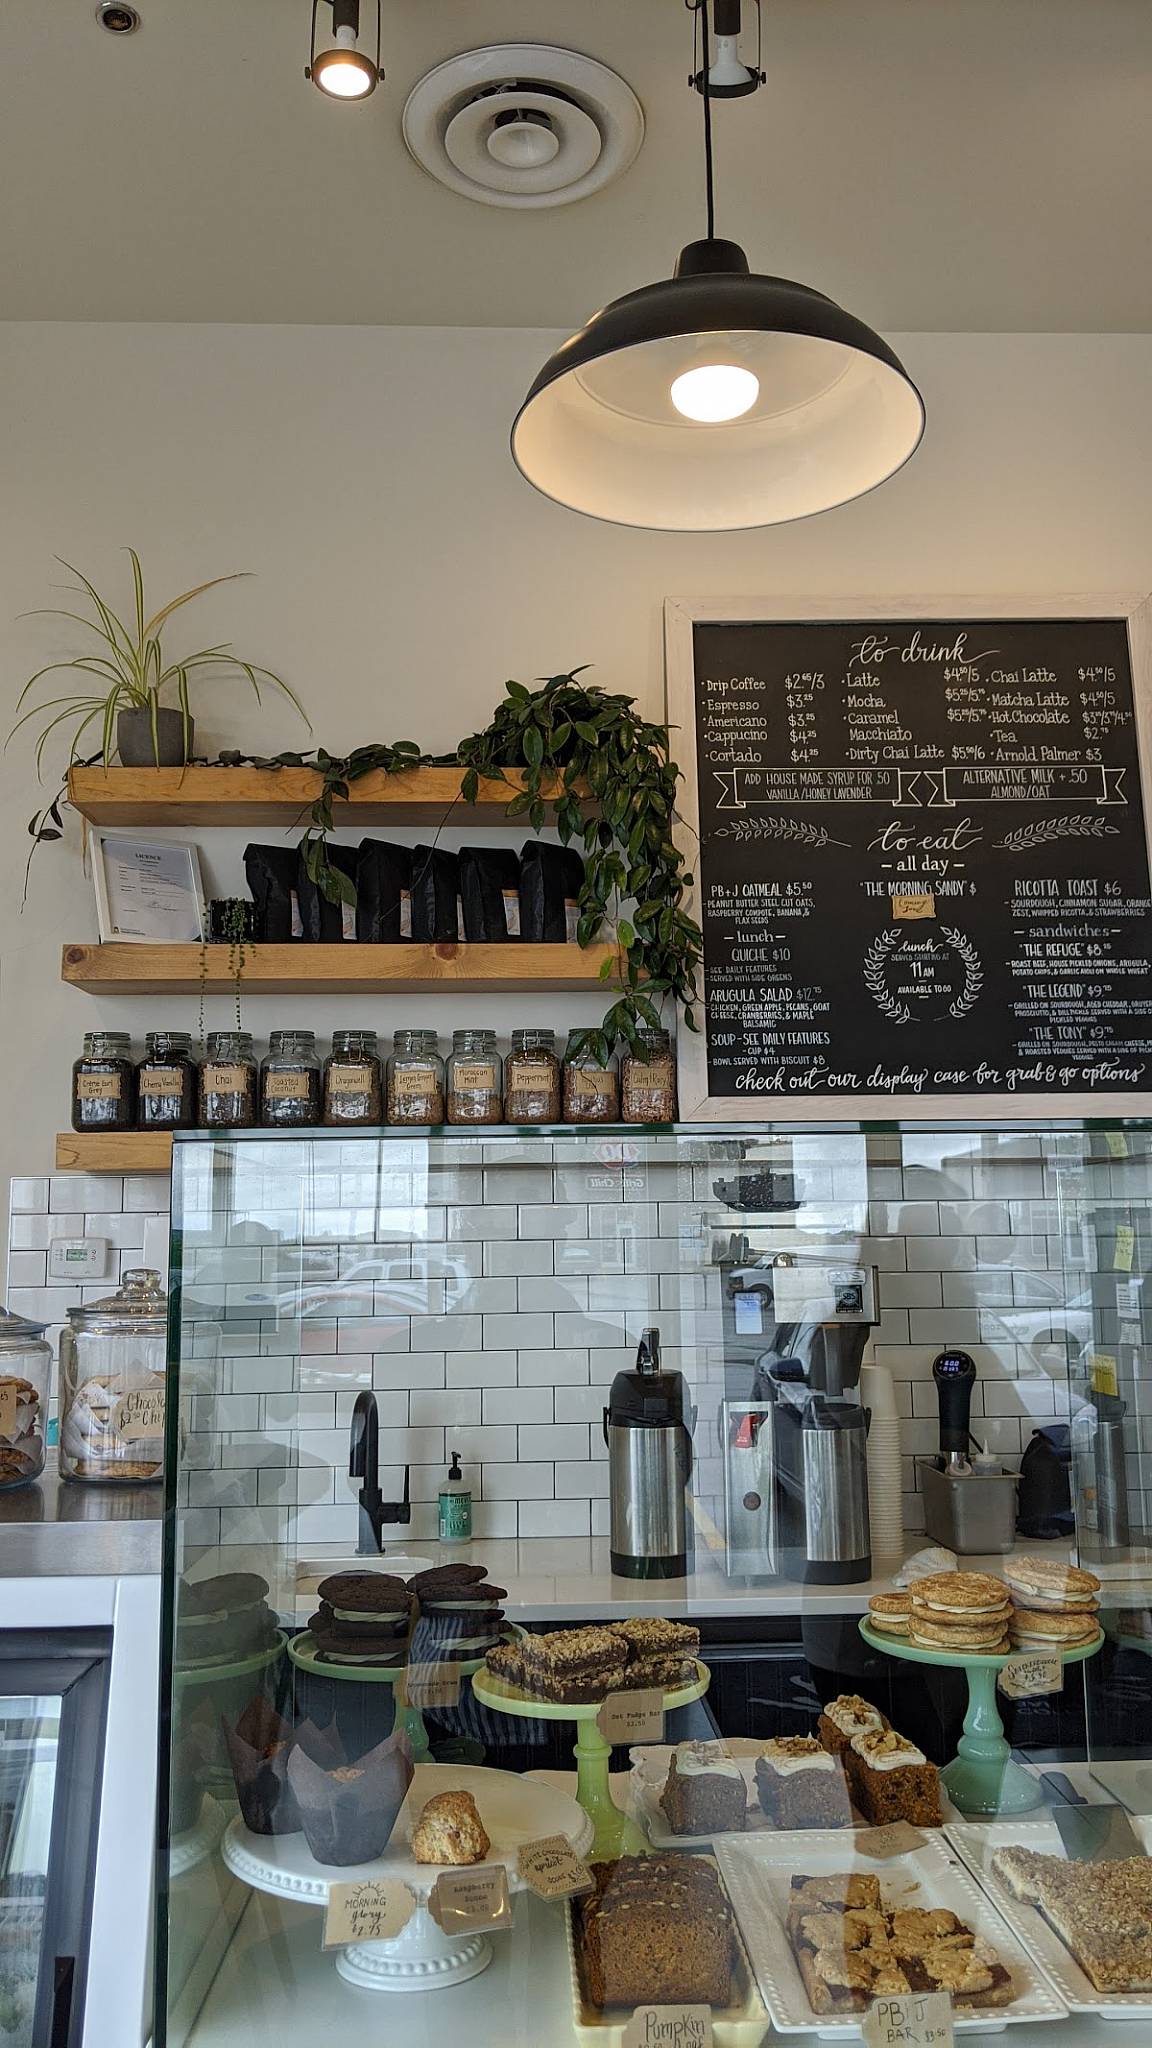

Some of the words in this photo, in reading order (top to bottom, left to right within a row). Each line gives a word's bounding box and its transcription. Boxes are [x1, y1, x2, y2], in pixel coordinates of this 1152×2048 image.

[849, 635, 900, 668] to
[901, 630, 1000, 664] drink
[847, 673, 881, 687] Latte
[991, 670, 1019, 683] Chai
[1022, 668, 1057, 682] Latte
[707, 680, 729, 695] Drip
[730, 677, 766, 690] Coffee
[707, 699, 760, 714] Espresso
[787, 693, 814, 709] $3.25
[848, 694, 886, 708] Mocha
[992, 692, 1035, 706] Matcha
[1036, 692, 1070, 706] Latte
[707, 715, 767, 726] Americano
[788, 713, 815, 727] $3.25
[848, 710, 900, 724] Caramel
[992, 711, 1012, 724] Hot
[1012, 710, 1071, 724] Chocolate
[708, 731, 768, 746] Cappucino
[790, 729, 817, 744] $4.25
[850, 728, 913, 741] Macchiato
[993, 730, 1018, 743] Tea
[709, 747, 762, 763] Cortado
[850, 747, 880, 764] Dirty
[883, 745, 911, 759] Chai
[914, 745, 946, 759] Latte
[996, 747, 1038, 762] Arnold
[1041, 746, 1082, 761] Palmer
[1086, 748, 1102, 761] $3
[744, 773, 761, 785] ADD
[766, 773, 797, 785] HOUSE
[800, 772, 824, 784] MADE
[827, 772, 855, 785] SYRUP
[857, 772, 874, 784] FOR
[963, 770, 1027, 784] ALTERNATIVE
[1031, 769, 1055, 783] MILK
[833, 787, 873, 800] LAVENDER
[990, 785, 1051, 799] ALMOND/OAT
[867, 821, 917, 851] to
[917, 818, 984, 851] eat
[896, 855, 918, 871] all
[921, 854, 950, 877] day
[711, 884, 738, 898] PB+J
[742, 882, 783, 897] OATMEAL
[888, 881, 932, 896] MORNING
[1014, 880, 1060, 896] RICOTTA
[1067, 879, 1099, 896] TOAST
[1103, 880, 1122, 896] $6
[737, 929, 775, 943] lunch
[1029, 923, 1110, 937] sandwiches
[898, 938, 943, 952] lunch
[731, 948, 769, 962] QUICHE
[772, 948, 792, 961] $10
[710, 988, 756, 1002] ARUGULA
[760, 987, 793, 1002] SALAD
[897, 985, 933, 994] AVAILABLE
[763, 1032, 786, 1045] DAILY
[788, 1031, 831, 1045] FEATURES
[747, 1047, 762, 1055] CUP
[733, 1056, 759, 1066] SERVED
[760, 1056, 780, 1065] WITH
[781, 1056, 810, 1065] BISCUIT
[812, 1055, 827, 1066] $8
[735, 1066, 787, 1091] check
[789, 1066, 830, 1090] out
[827, 1073, 863, 1089] our
[867, 1064, 930, 1094] display
[933, 1070, 970, 1083] case
[972, 1062, 1002, 1085] for
[1058, 1067, 1080, 1086] go
[1081, 1056, 1146, 1087] options
[344, 1896, 386, 1909] MORNING
[350, 1909, 386, 1925] glory
[887, 2026, 922, 2044] BAR
